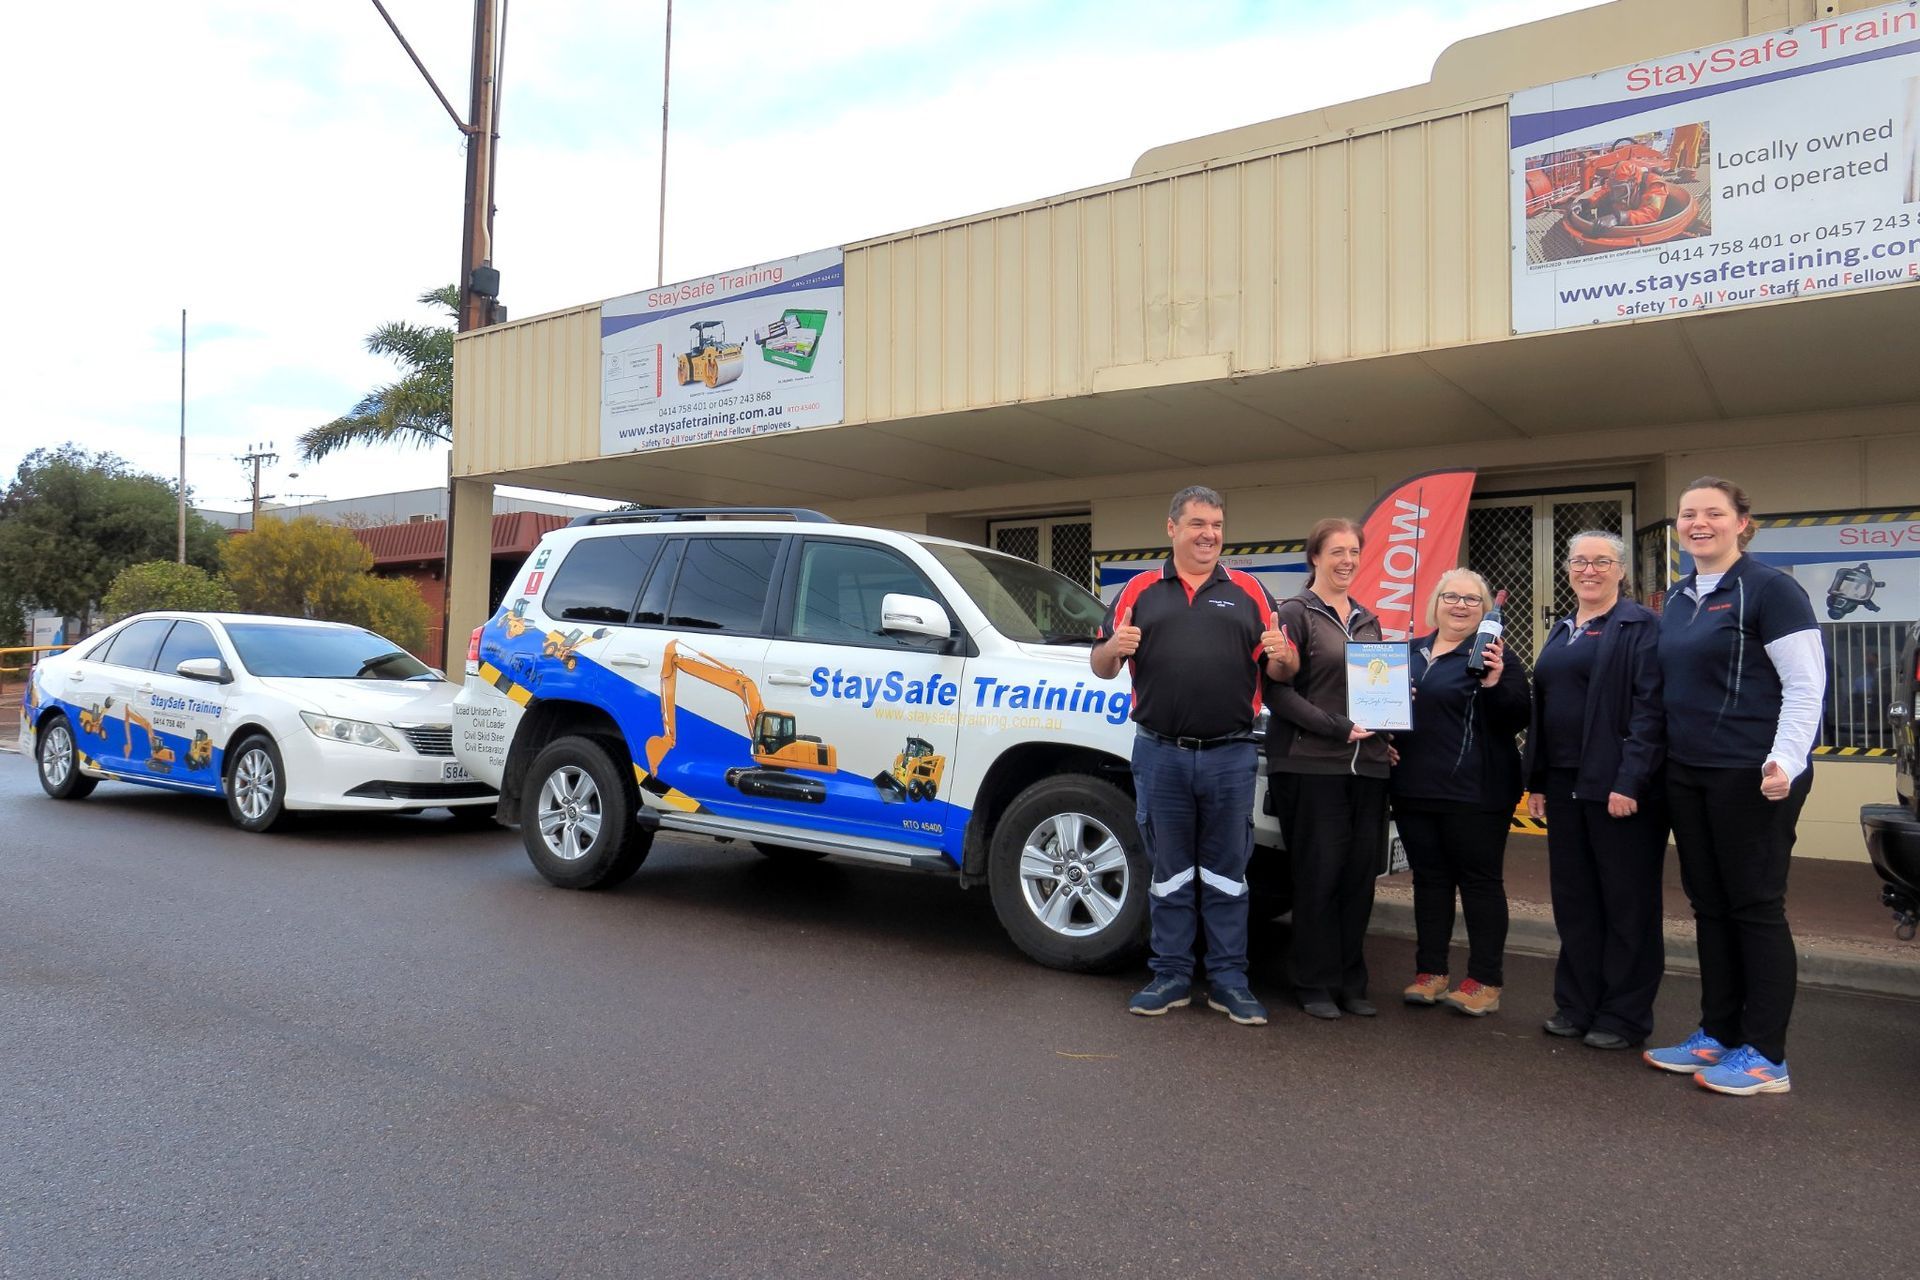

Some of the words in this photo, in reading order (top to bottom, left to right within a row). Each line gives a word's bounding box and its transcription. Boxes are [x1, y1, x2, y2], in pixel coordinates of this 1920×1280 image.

[1626, 37, 1799, 93] StaySafe
[1717, 139, 1799, 170] Locally
[1806, 118, 1894, 153] owned
[1721, 174, 1766, 200] and
[1774, 152, 1889, 193] operated
[1658, 245, 1705, 265] 0414
[1709, 239, 1744, 257] 758
[1748, 233, 1784, 251] 401
[1789, 231, 1811, 244] or
[1815, 220, 1867, 241] 0457
[1872, 213, 1911, 232] 243
[647, 282, 715, 308] StaySafe
[719, 266, 784, 291] Training
[1616, 300, 1666, 317] Safety
[1668, 296, 1689, 309] To
[1692, 291, 1713, 306] All
[1717, 288, 1756, 302] Your
[1759, 278, 1800, 297] Staff
[1803, 273, 1838, 291] And
[1843, 267, 1903, 285] Fellow
[658, 406, 677, 418] 0414
[679, 403, 692, 414] 758
[693, 401, 707, 412] 401
[709, 401, 717, 409] or
[718, 396, 738, 408] 0457
[739, 393, 755, 405] 243
[756, 391, 772, 402] 868
[618, 405, 783, 439] www.staysafetraining.com.au
[641, 439, 661, 449] Safety
[662, 437, 670, 445] To
[671, 436, 680, 444] All
[681, 434, 696, 443] Your
[697, 432, 713, 441] Staff
[713, 429, 728, 438] And
[728, 426, 751, 436] Fellow
[752, 420, 791, 434] Employees
[1376, 499, 1430, 612] NOW
[150, 694, 186, 711] StaySafe
[188, 698, 222, 718] Training
[810, 666, 957, 708] StaySafe
[973, 676, 1132, 725] Training
[176, 720, 186, 729] 401
[455, 706, 470, 715] Load
[470, 707, 491, 717] Unload
[492, 707, 507, 717] Plant
[472, 718, 485, 728] Civil
[486, 719, 506, 729] Loader
[874, 706, 1063, 731] www.staysafetraining.com.au
[464, 731, 476, 741] Civil
[477, 731, 490, 742] Skid
[491, 733, 505, 742] Steer
[465, 742, 477, 752] Civil
[477, 743, 504, 755] Excavator
[489, 756, 504, 767] Roller
[903, 819, 919, 830] RTO
[921, 822, 943, 833] 45400
